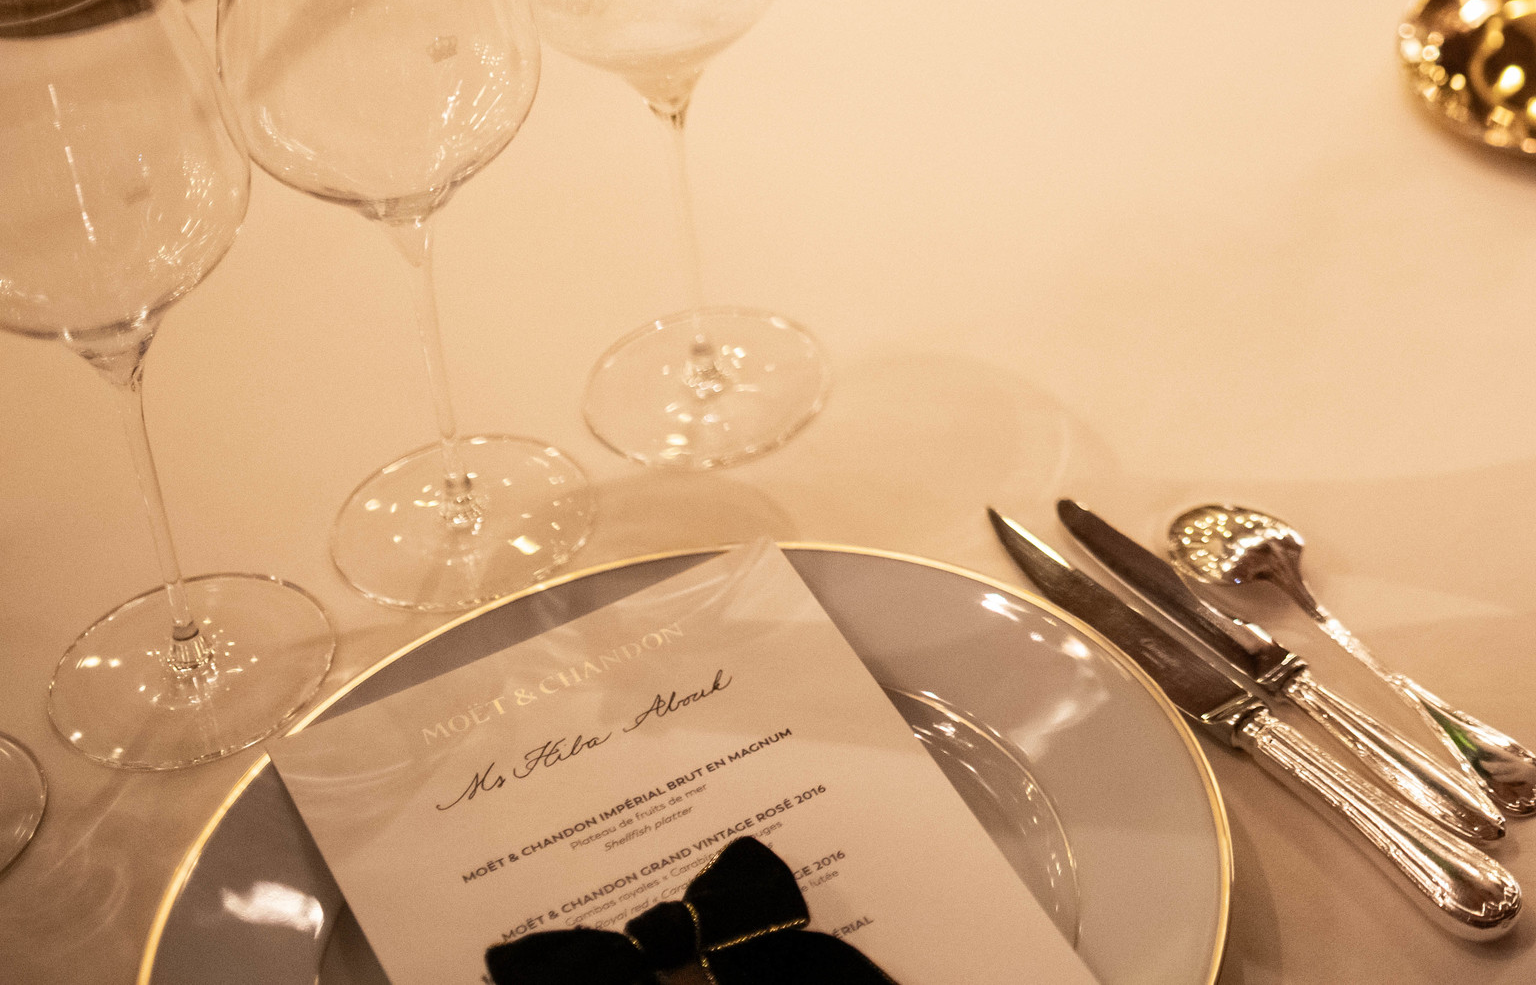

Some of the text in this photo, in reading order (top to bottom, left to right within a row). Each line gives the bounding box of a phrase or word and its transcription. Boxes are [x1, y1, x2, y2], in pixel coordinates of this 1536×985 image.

[420, 621, 683, 747] MOËT & CHANDON
[460, 726, 793, 884] MOËT & CHANDON IMPÉRIAL BRUT EN MAGNUM
[568, 783, 706, 850] Plateau de fruits de mer
[603, 805, 693, 852] Shellfish platter
[500, 913, 546, 943] MOËT
[546, 909, 560, 920] &
[559, 871, 639, 914] CHANDON
[638, 846, 692, 877] GRAND
[691, 817, 754, 851] VINTAGE
[754, 797, 793, 823] ROSÉ
[793, 783, 827, 805] 2016
[811, 849, 846, 871] 2016
